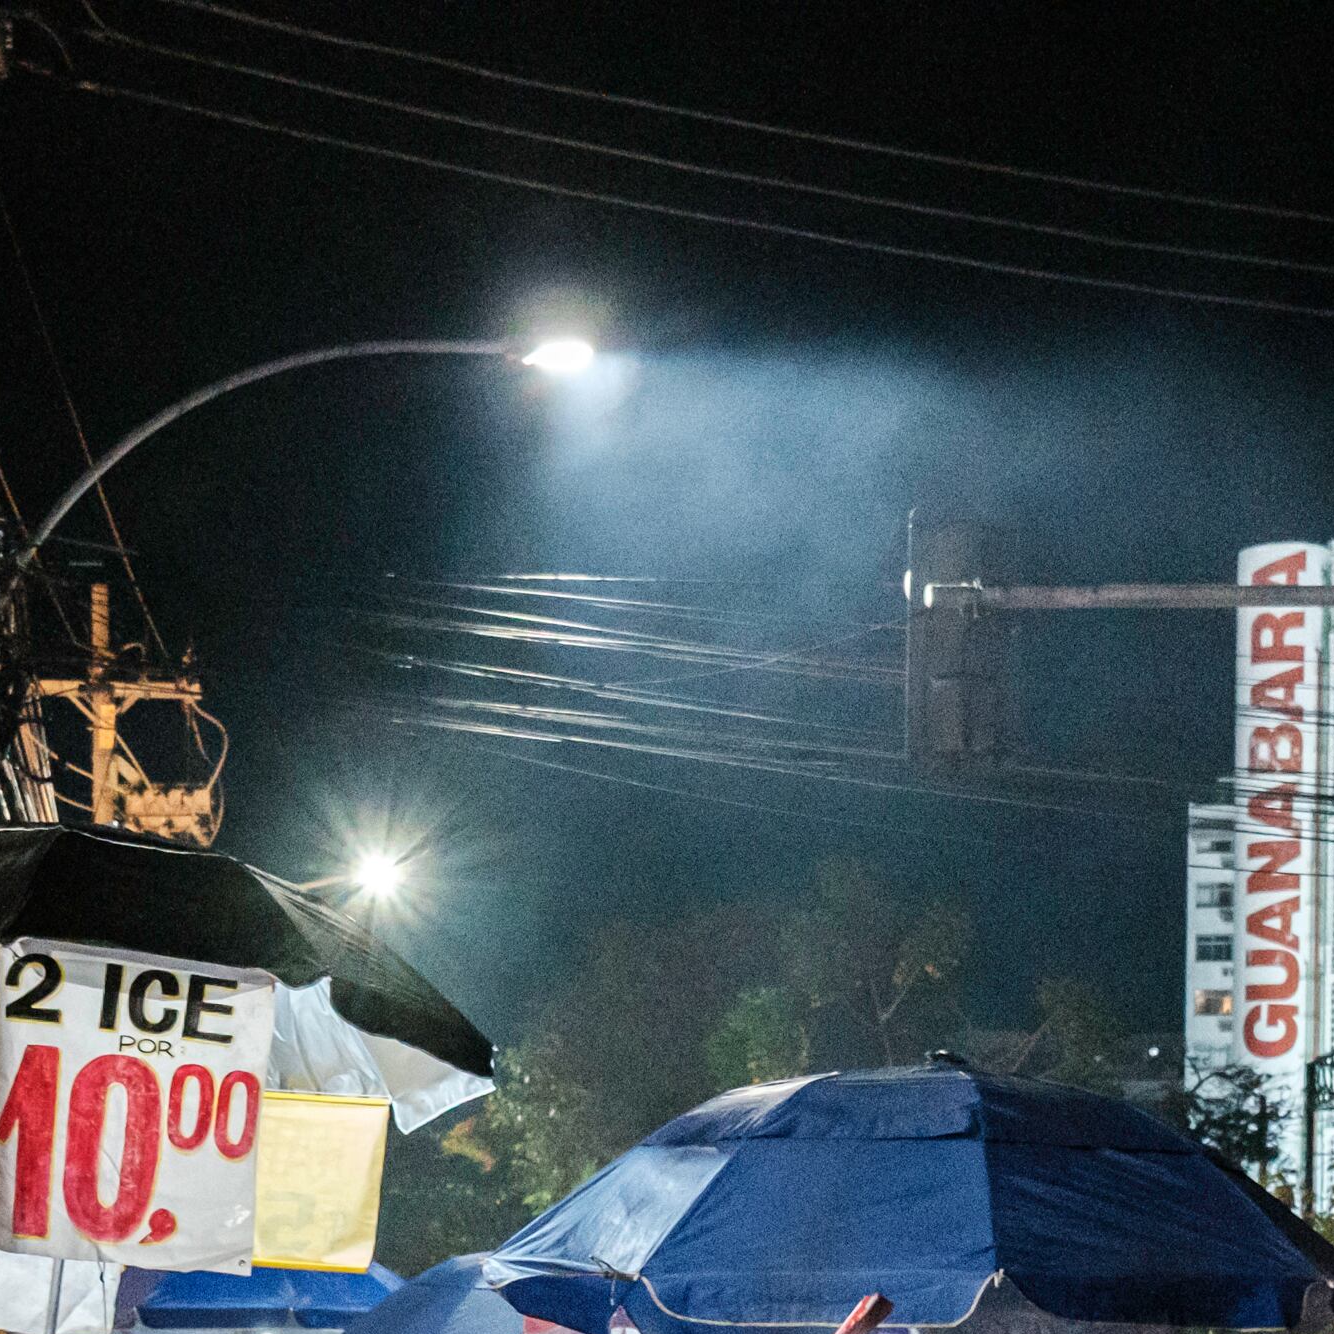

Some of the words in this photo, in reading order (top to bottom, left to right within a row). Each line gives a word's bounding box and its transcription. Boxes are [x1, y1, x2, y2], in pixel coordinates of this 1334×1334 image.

[1242, 549, 1308, 1058] GUANABARA
[4, 952, 63, 1024] 2
[99, 963, 240, 1045] ICE
[118, 1034, 176, 1058] POR
